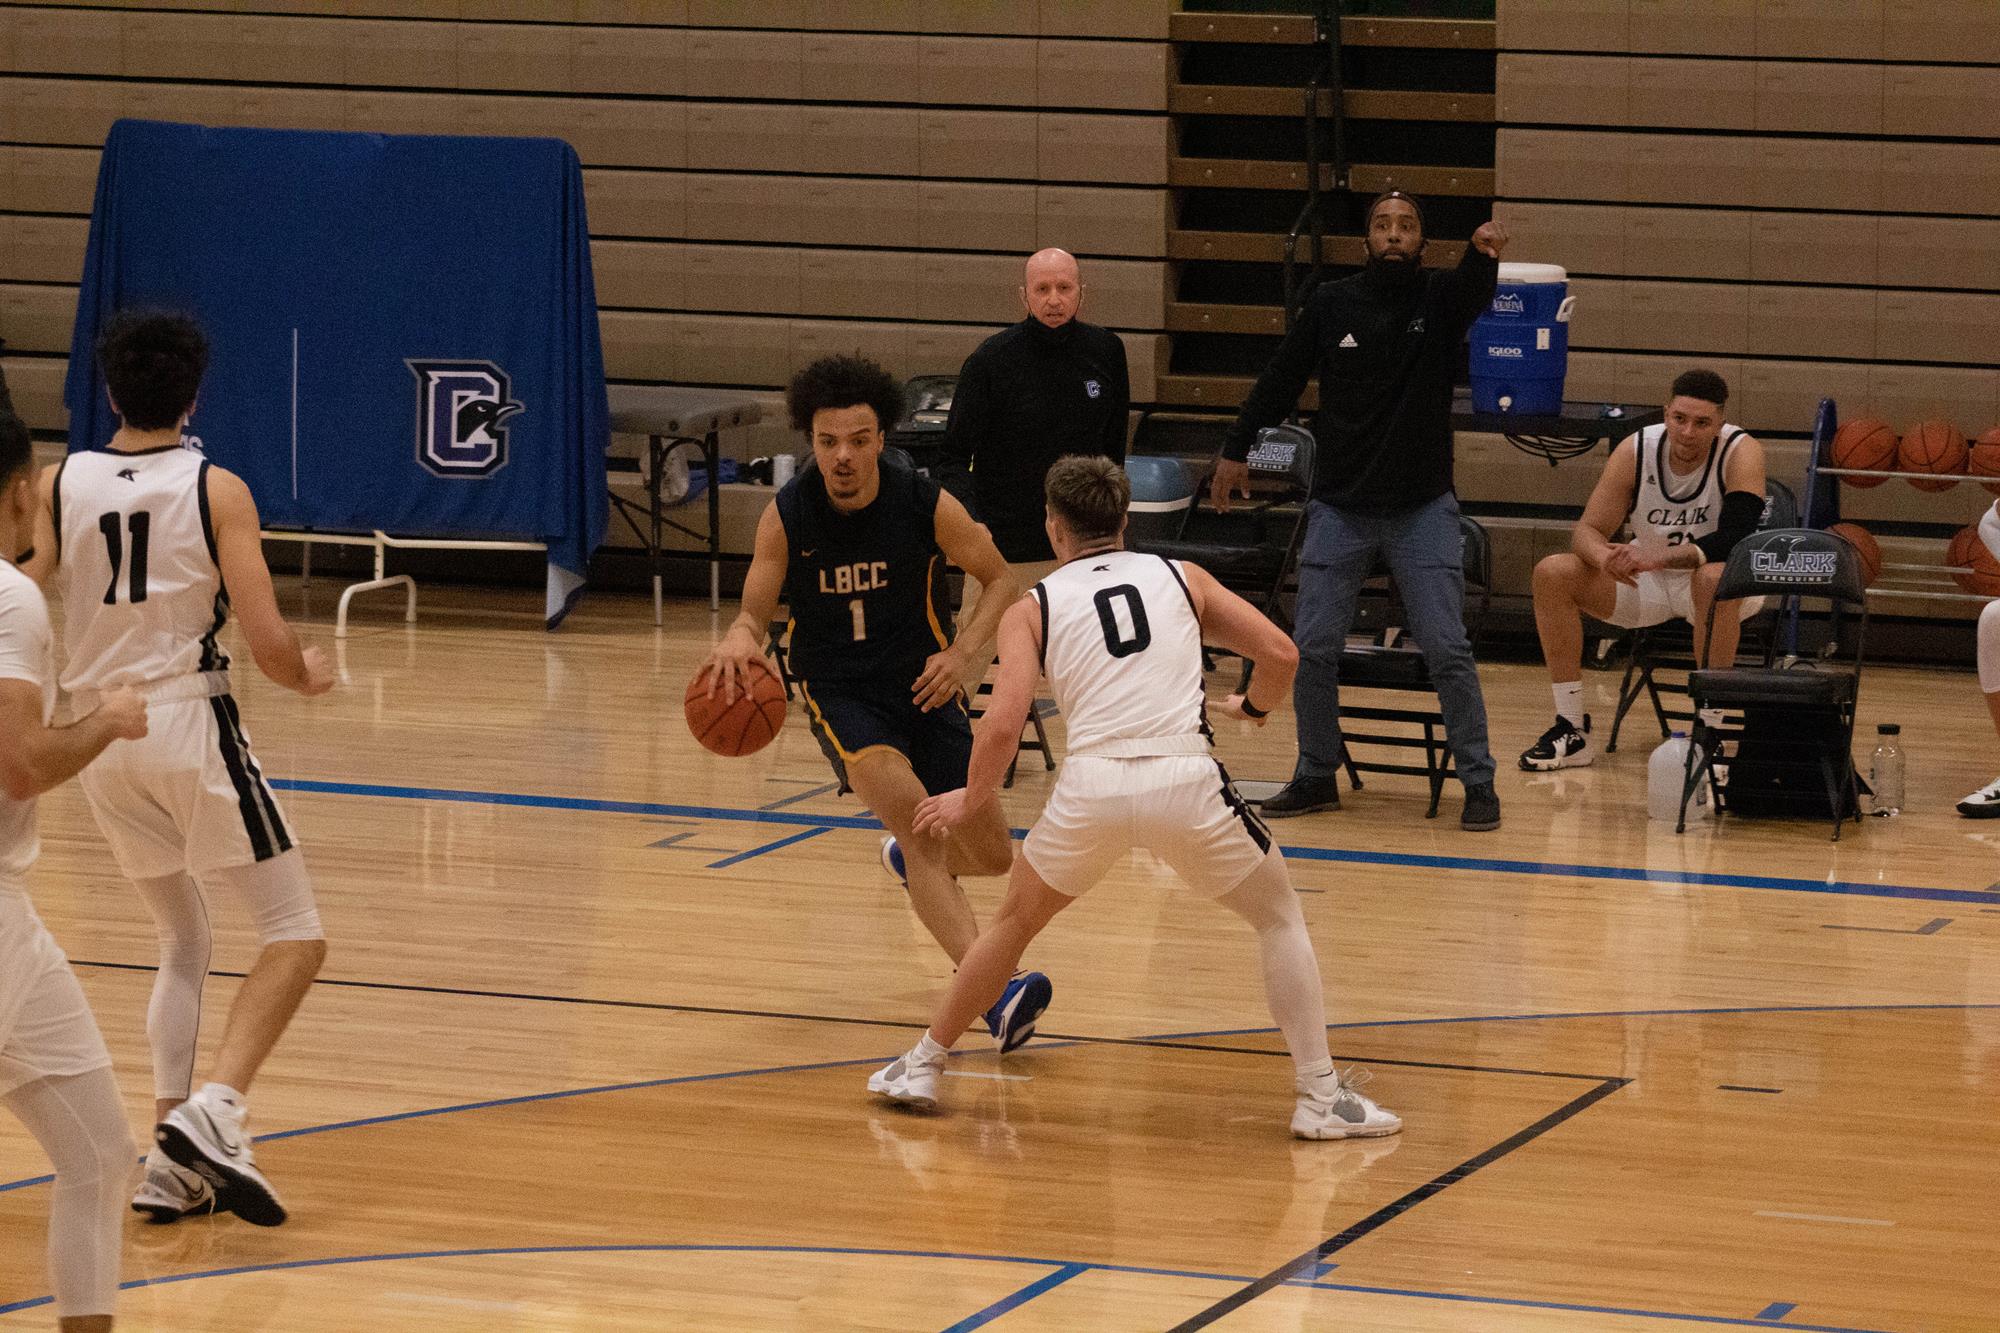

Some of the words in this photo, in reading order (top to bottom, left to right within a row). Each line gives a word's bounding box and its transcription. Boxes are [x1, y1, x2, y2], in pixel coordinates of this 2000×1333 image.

[1488, 346, 1522, 356] IGLOO
[99, 511, 150, 605] 11
[1751, 551, 1837, 574] CLARK
[819, 561, 888, 594] LBCC
[1763, 575, 1822, 583] PENGUINS
[849, 599, 867, 641] 1
[1093, 583, 1151, 659] 0
